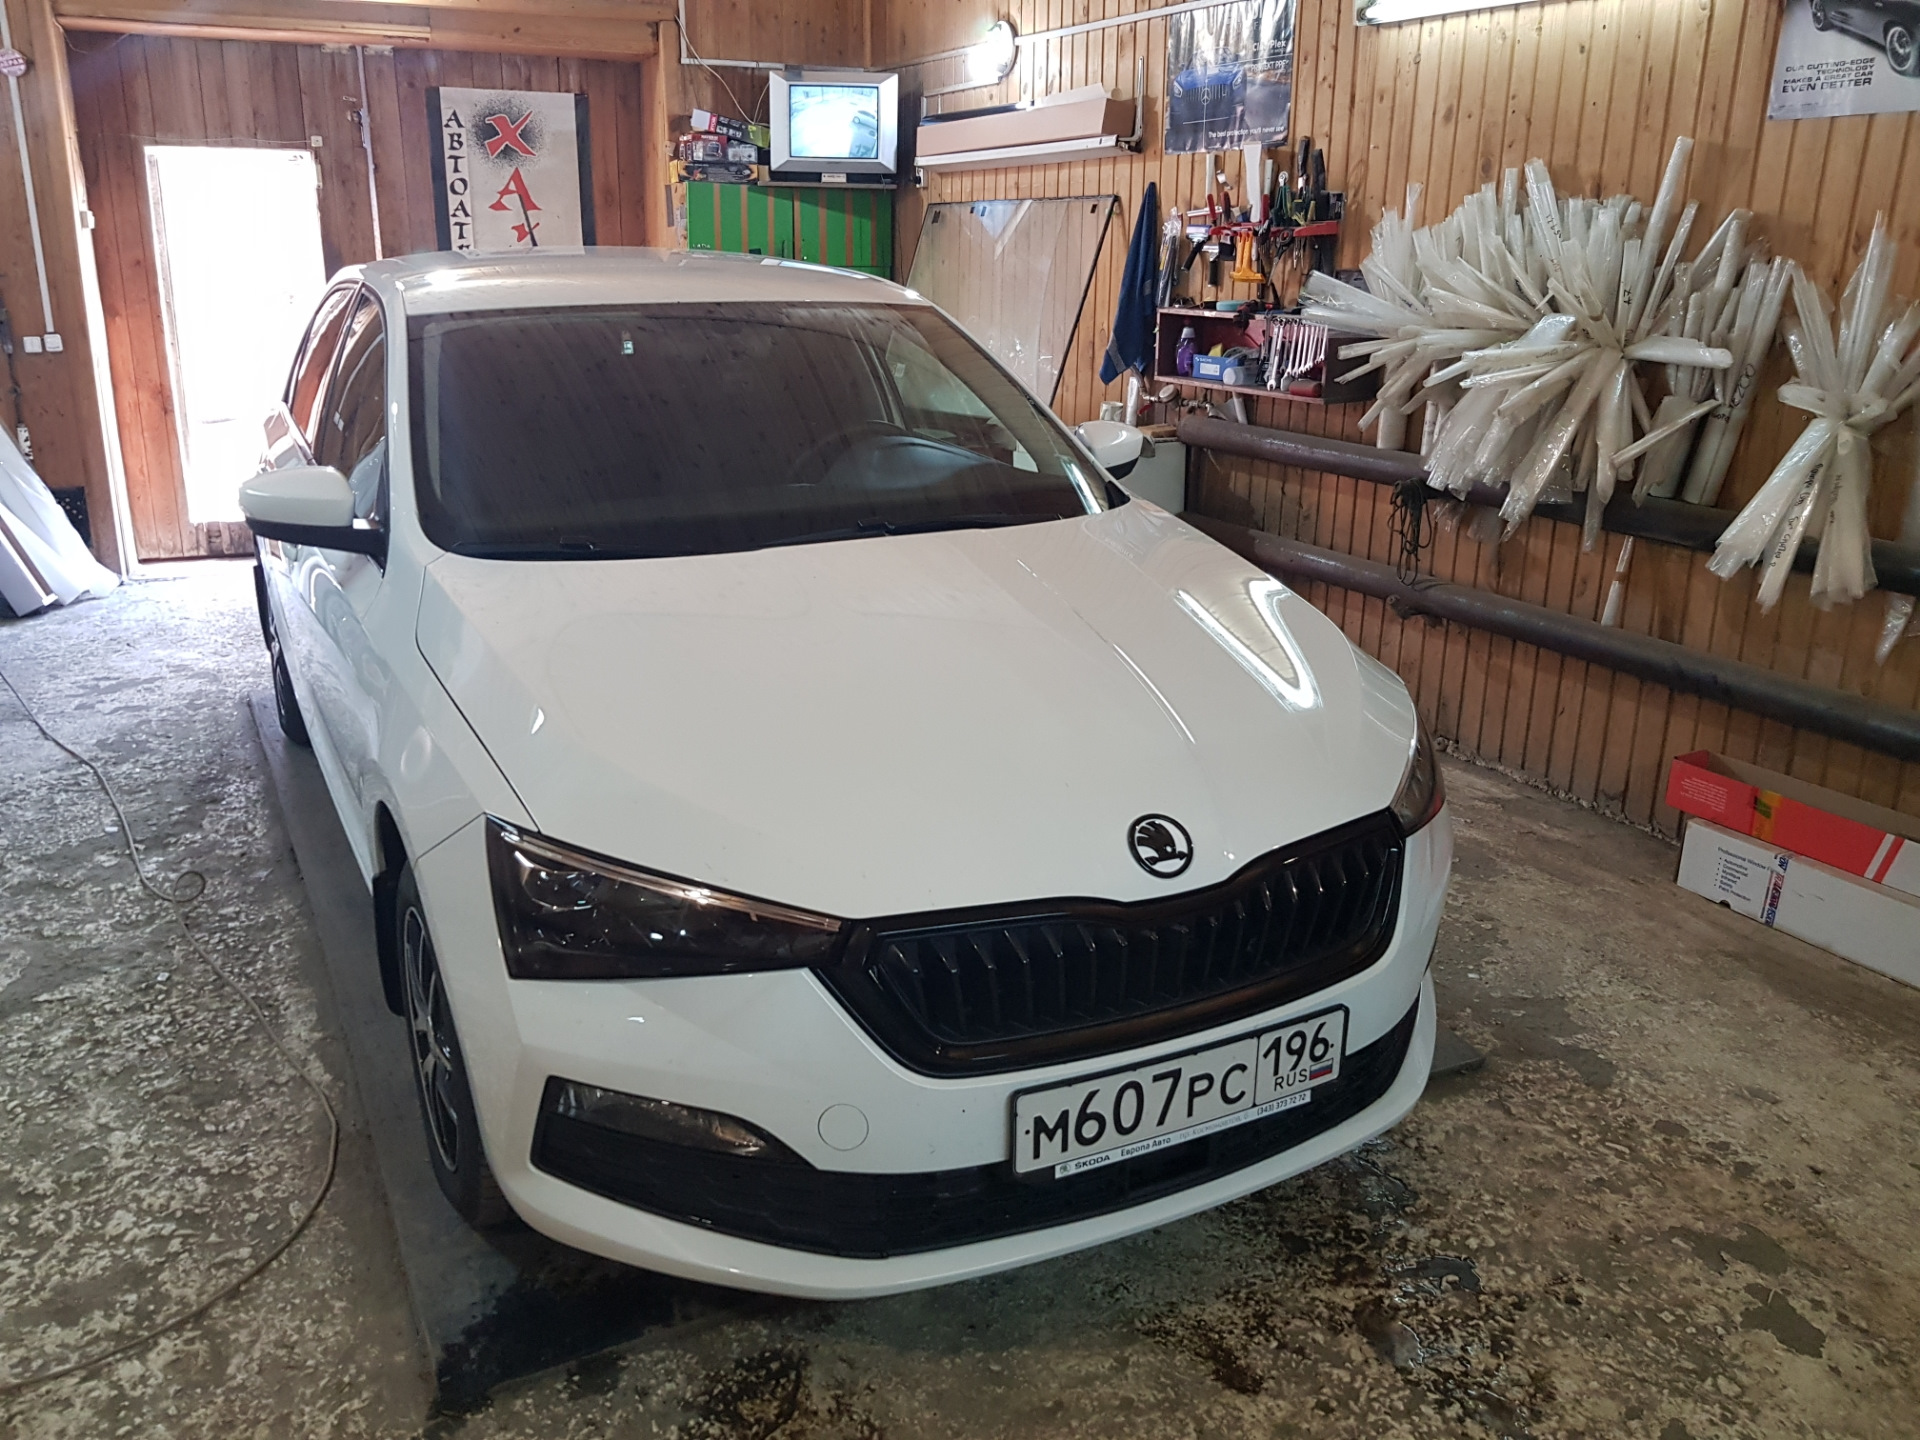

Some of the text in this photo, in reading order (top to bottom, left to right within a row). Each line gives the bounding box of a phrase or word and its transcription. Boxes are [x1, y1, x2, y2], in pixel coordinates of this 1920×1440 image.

[1786, 57, 1876, 73] OUR CUTTING-EDGE
[1817, 64, 1875, 75] TECHNOLOGY
[1783, 75, 1813, 85] MAKES
[1824, 73, 1852, 81] GREAT
[1854, 70, 1874, 78] CAR
[1782, 83, 1816, 93] EVEN
[1208, 131, 1217, 139] The
[1227, 129, 1249, 137] protection
[1724, 859, 1748, 871] Automotive
[1262, 1021, 1330, 1077] 196
[1274, 1067, 1308, 1092] RUS
[1120, 1142, 1150, 1157] Европа
[1151, 1137, 1171, 1148] Авто
[1257, 1105, 1275, 1117] (343)
[1275, 1099, 1288, 1110] 373
[1288, 1096, 1297, 1105] 72
[1297, 1093, 1307, 1103] 72
